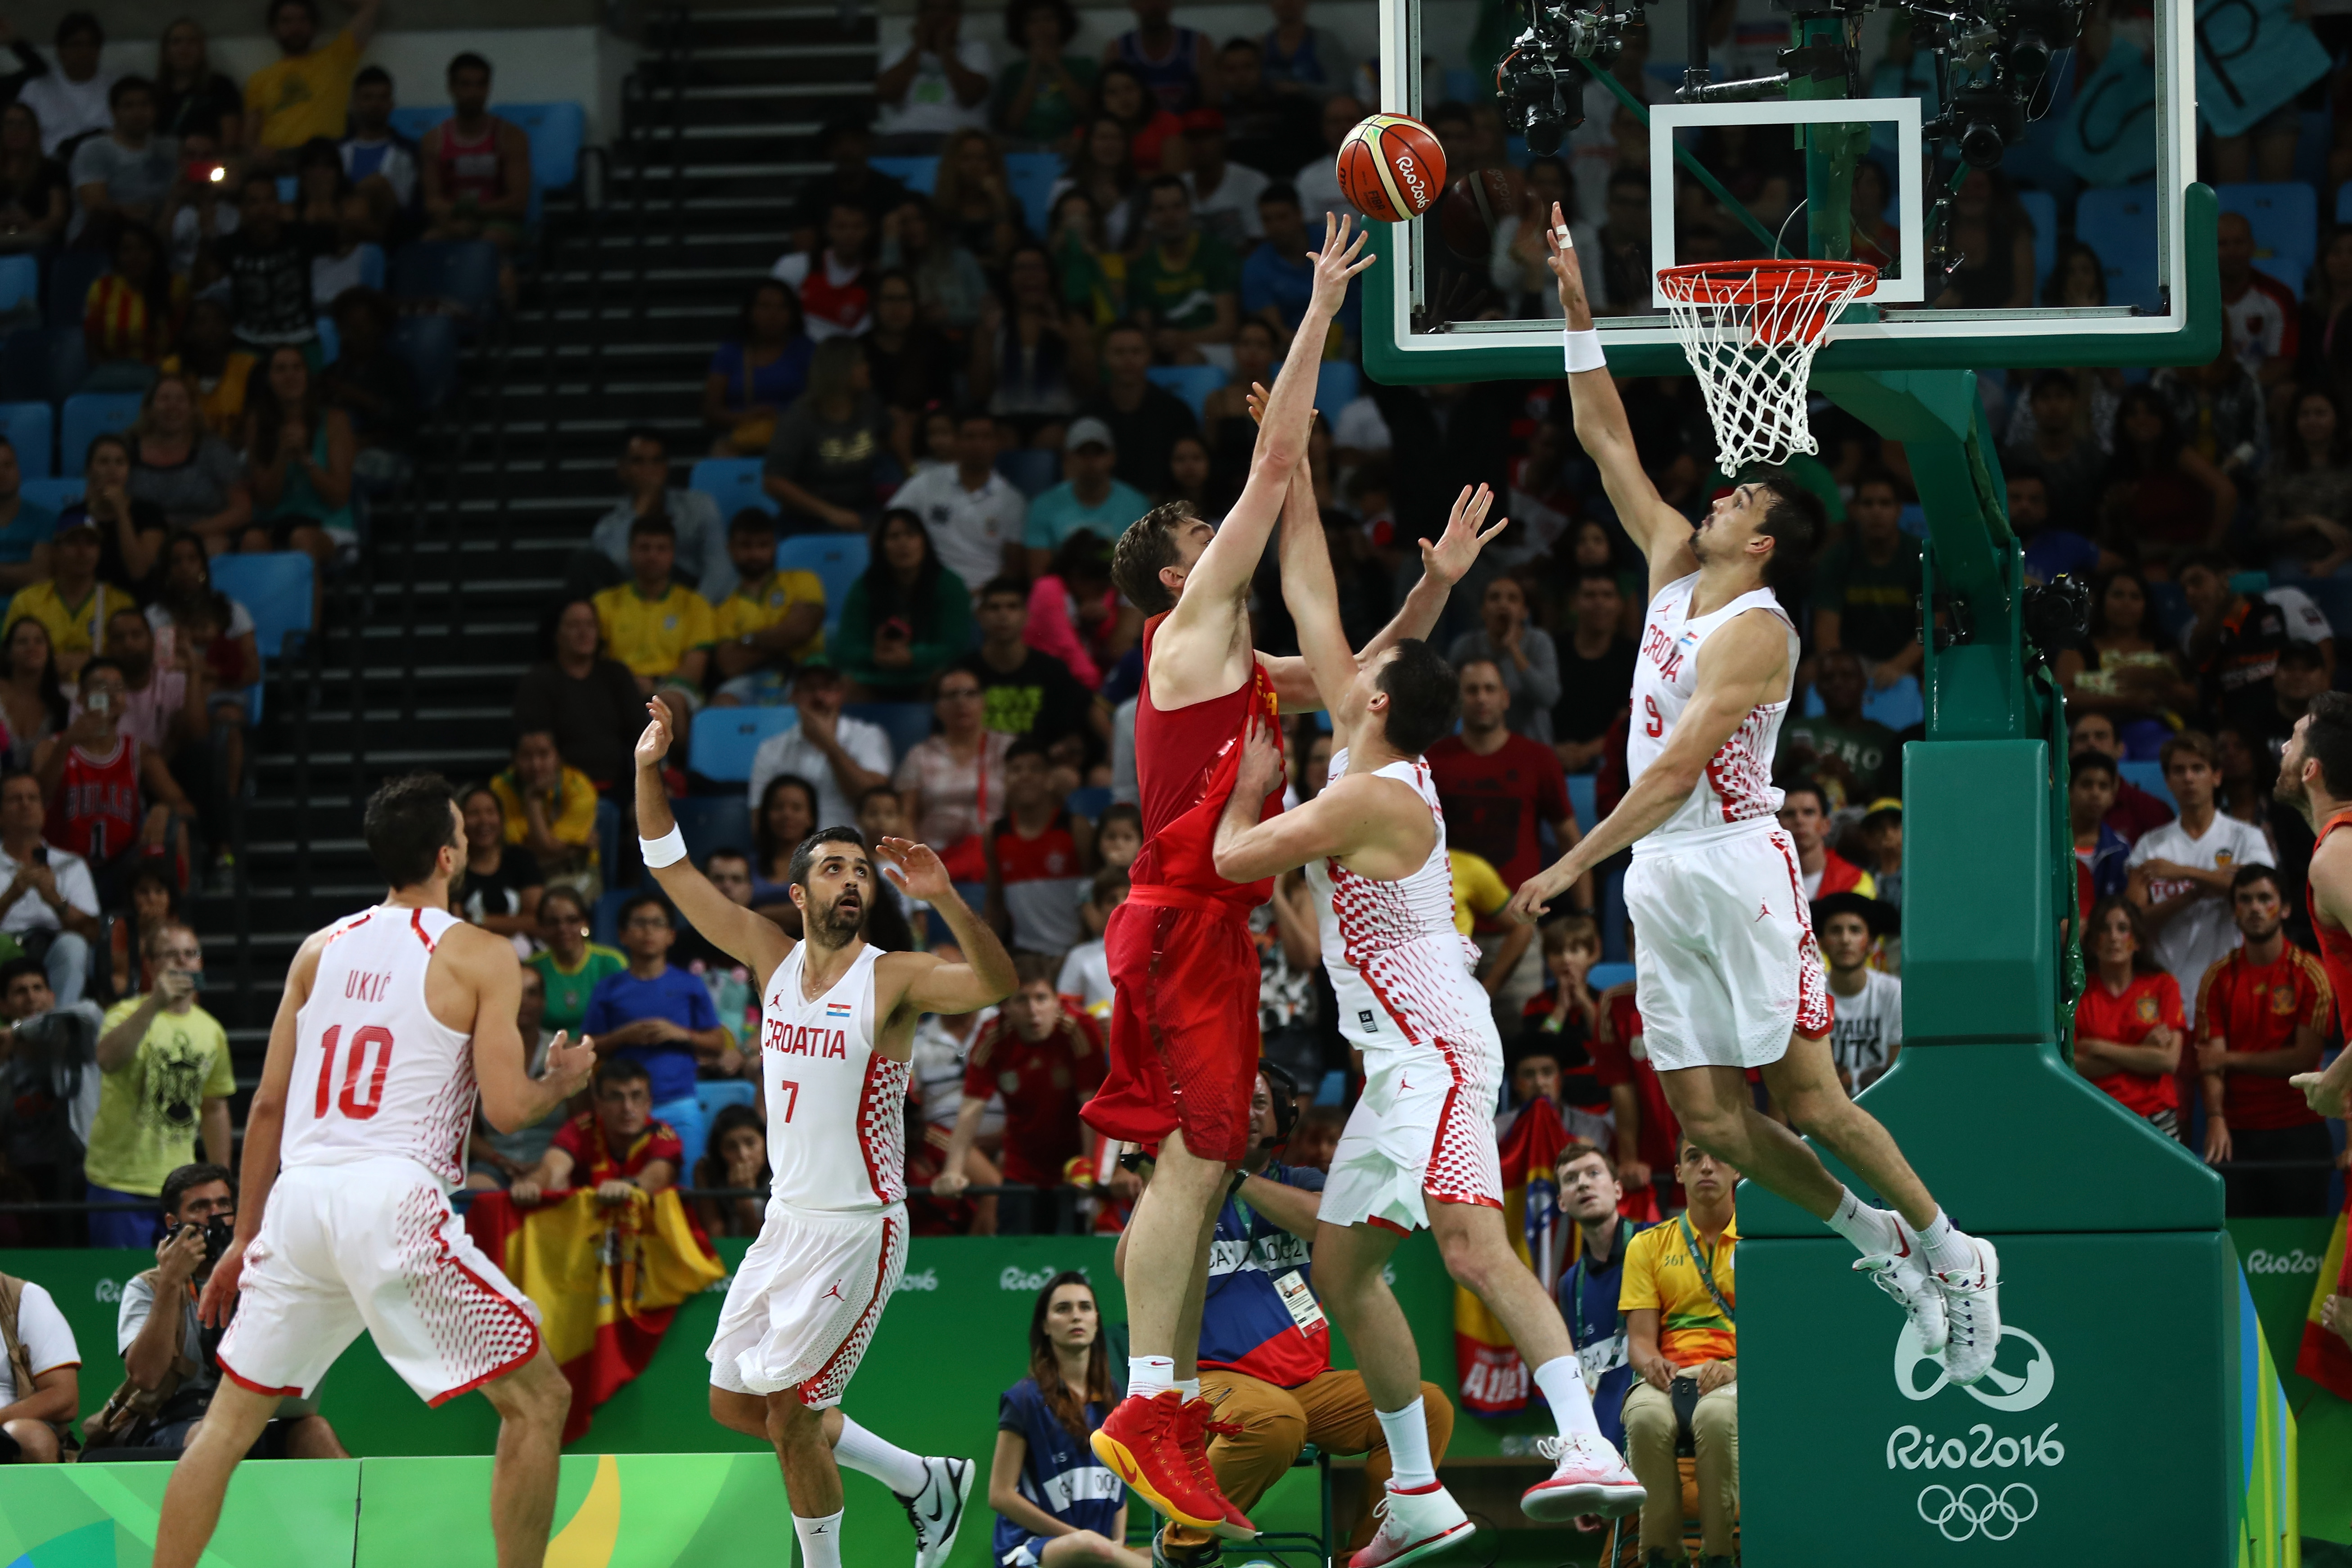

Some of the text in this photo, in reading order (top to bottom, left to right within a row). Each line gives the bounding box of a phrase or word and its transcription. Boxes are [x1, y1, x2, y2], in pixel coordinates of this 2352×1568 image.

[1368, 190, 1386, 211] FIBA
[1645, 694, 1663, 738] 9
[90, 817, 108, 859] 1
[345, 970, 392, 1003] UKIĆ
[765, 1018, 846, 1060] CROATIA
[314, 1025, 394, 1120] 10
[781, 1080, 799, 1123] 7
[1886, 1422, 2065, 1470] Rio2016
